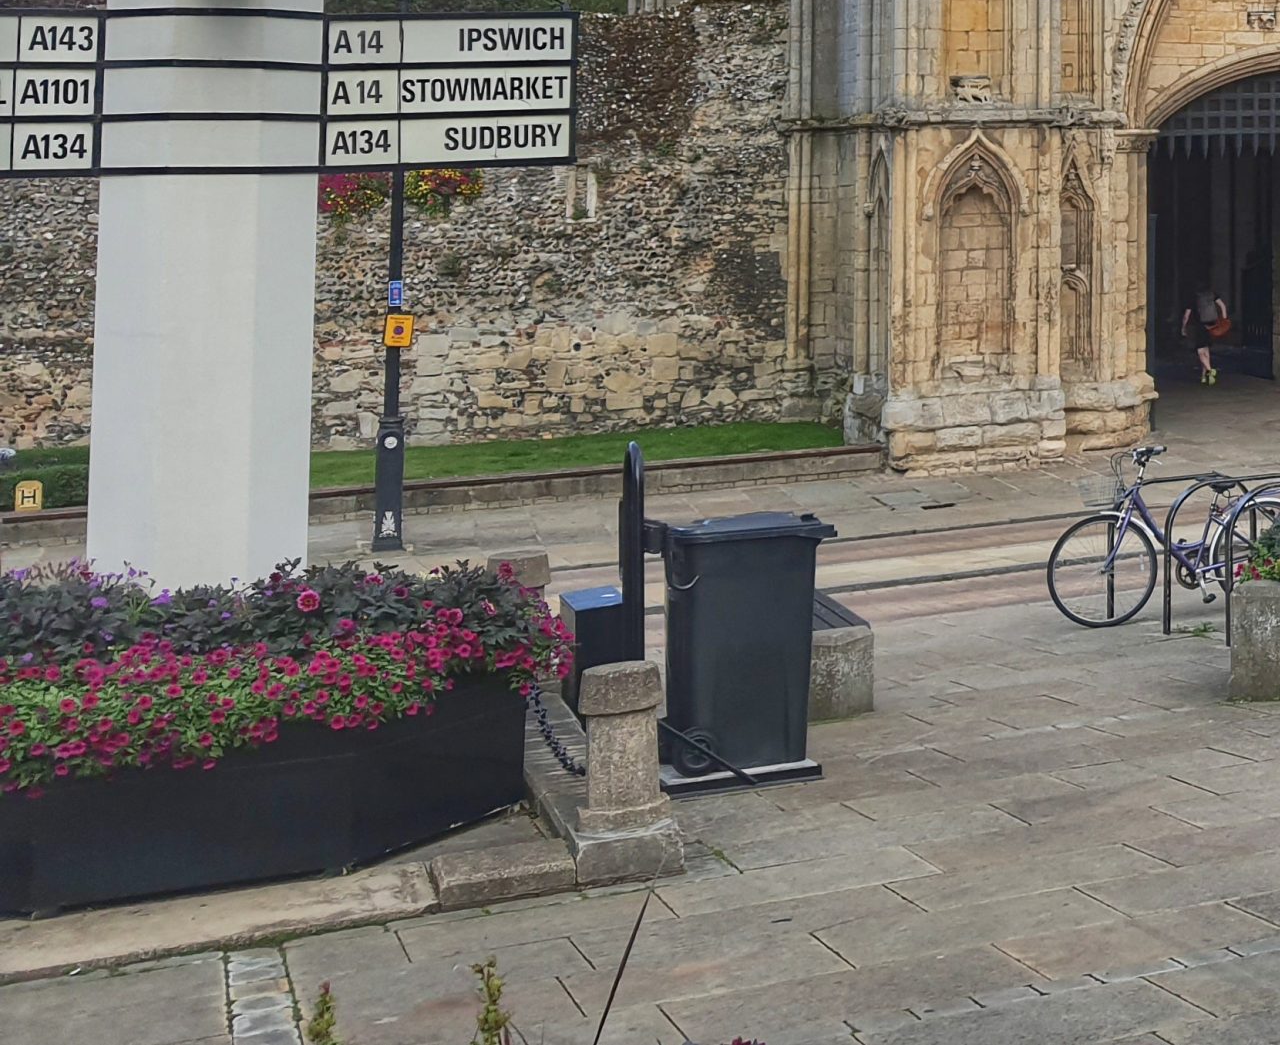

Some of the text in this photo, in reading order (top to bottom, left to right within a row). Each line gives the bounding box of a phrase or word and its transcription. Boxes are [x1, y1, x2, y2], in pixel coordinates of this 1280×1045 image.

[28, 25, 94, 51] A143
[333, 27, 564, 54] A 14 IPSWICH
[19, 79, 89, 105] A1101
[331, 76, 568, 105] A 14 STOWMARKET
[21, 134, 87, 160] A134
[331, 123, 562, 155] A134 SUDBURY
[21, 488, 37, 506] H
